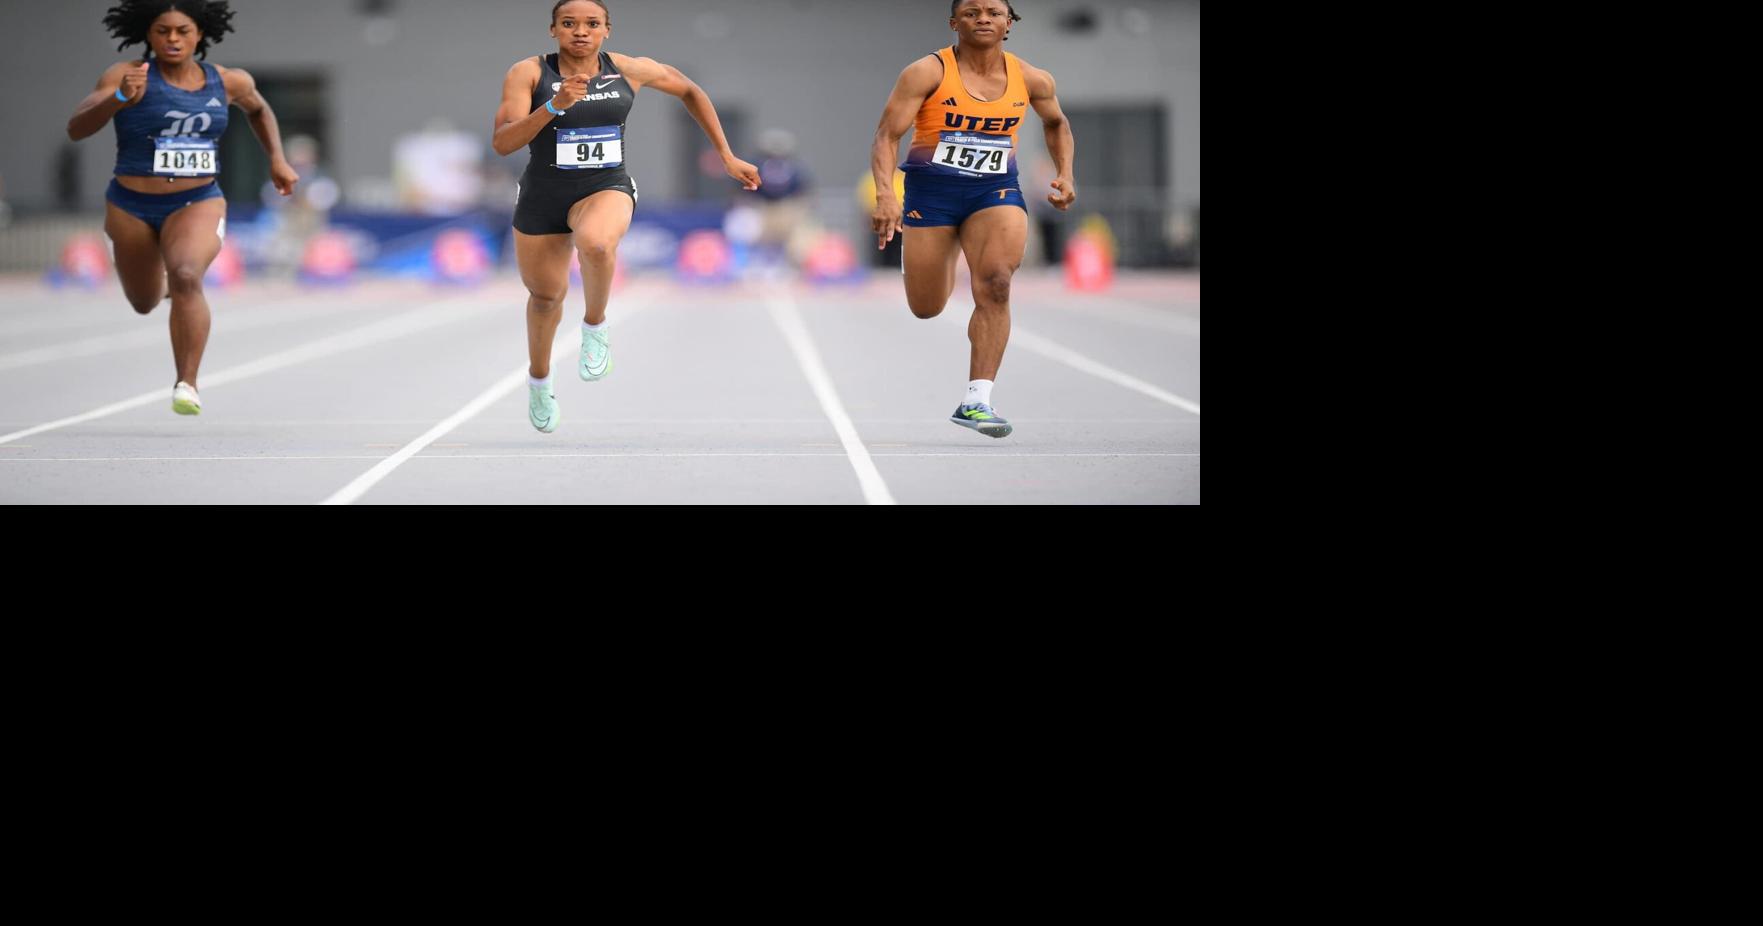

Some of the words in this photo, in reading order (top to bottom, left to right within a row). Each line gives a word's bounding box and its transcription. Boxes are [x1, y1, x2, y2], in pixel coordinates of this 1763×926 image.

[945, 112, 1020, 131] UTEP
[160, 151, 210, 169] 1048
[576, 143, 605, 162] 94
[941, 145, 1004, 172] 1579
